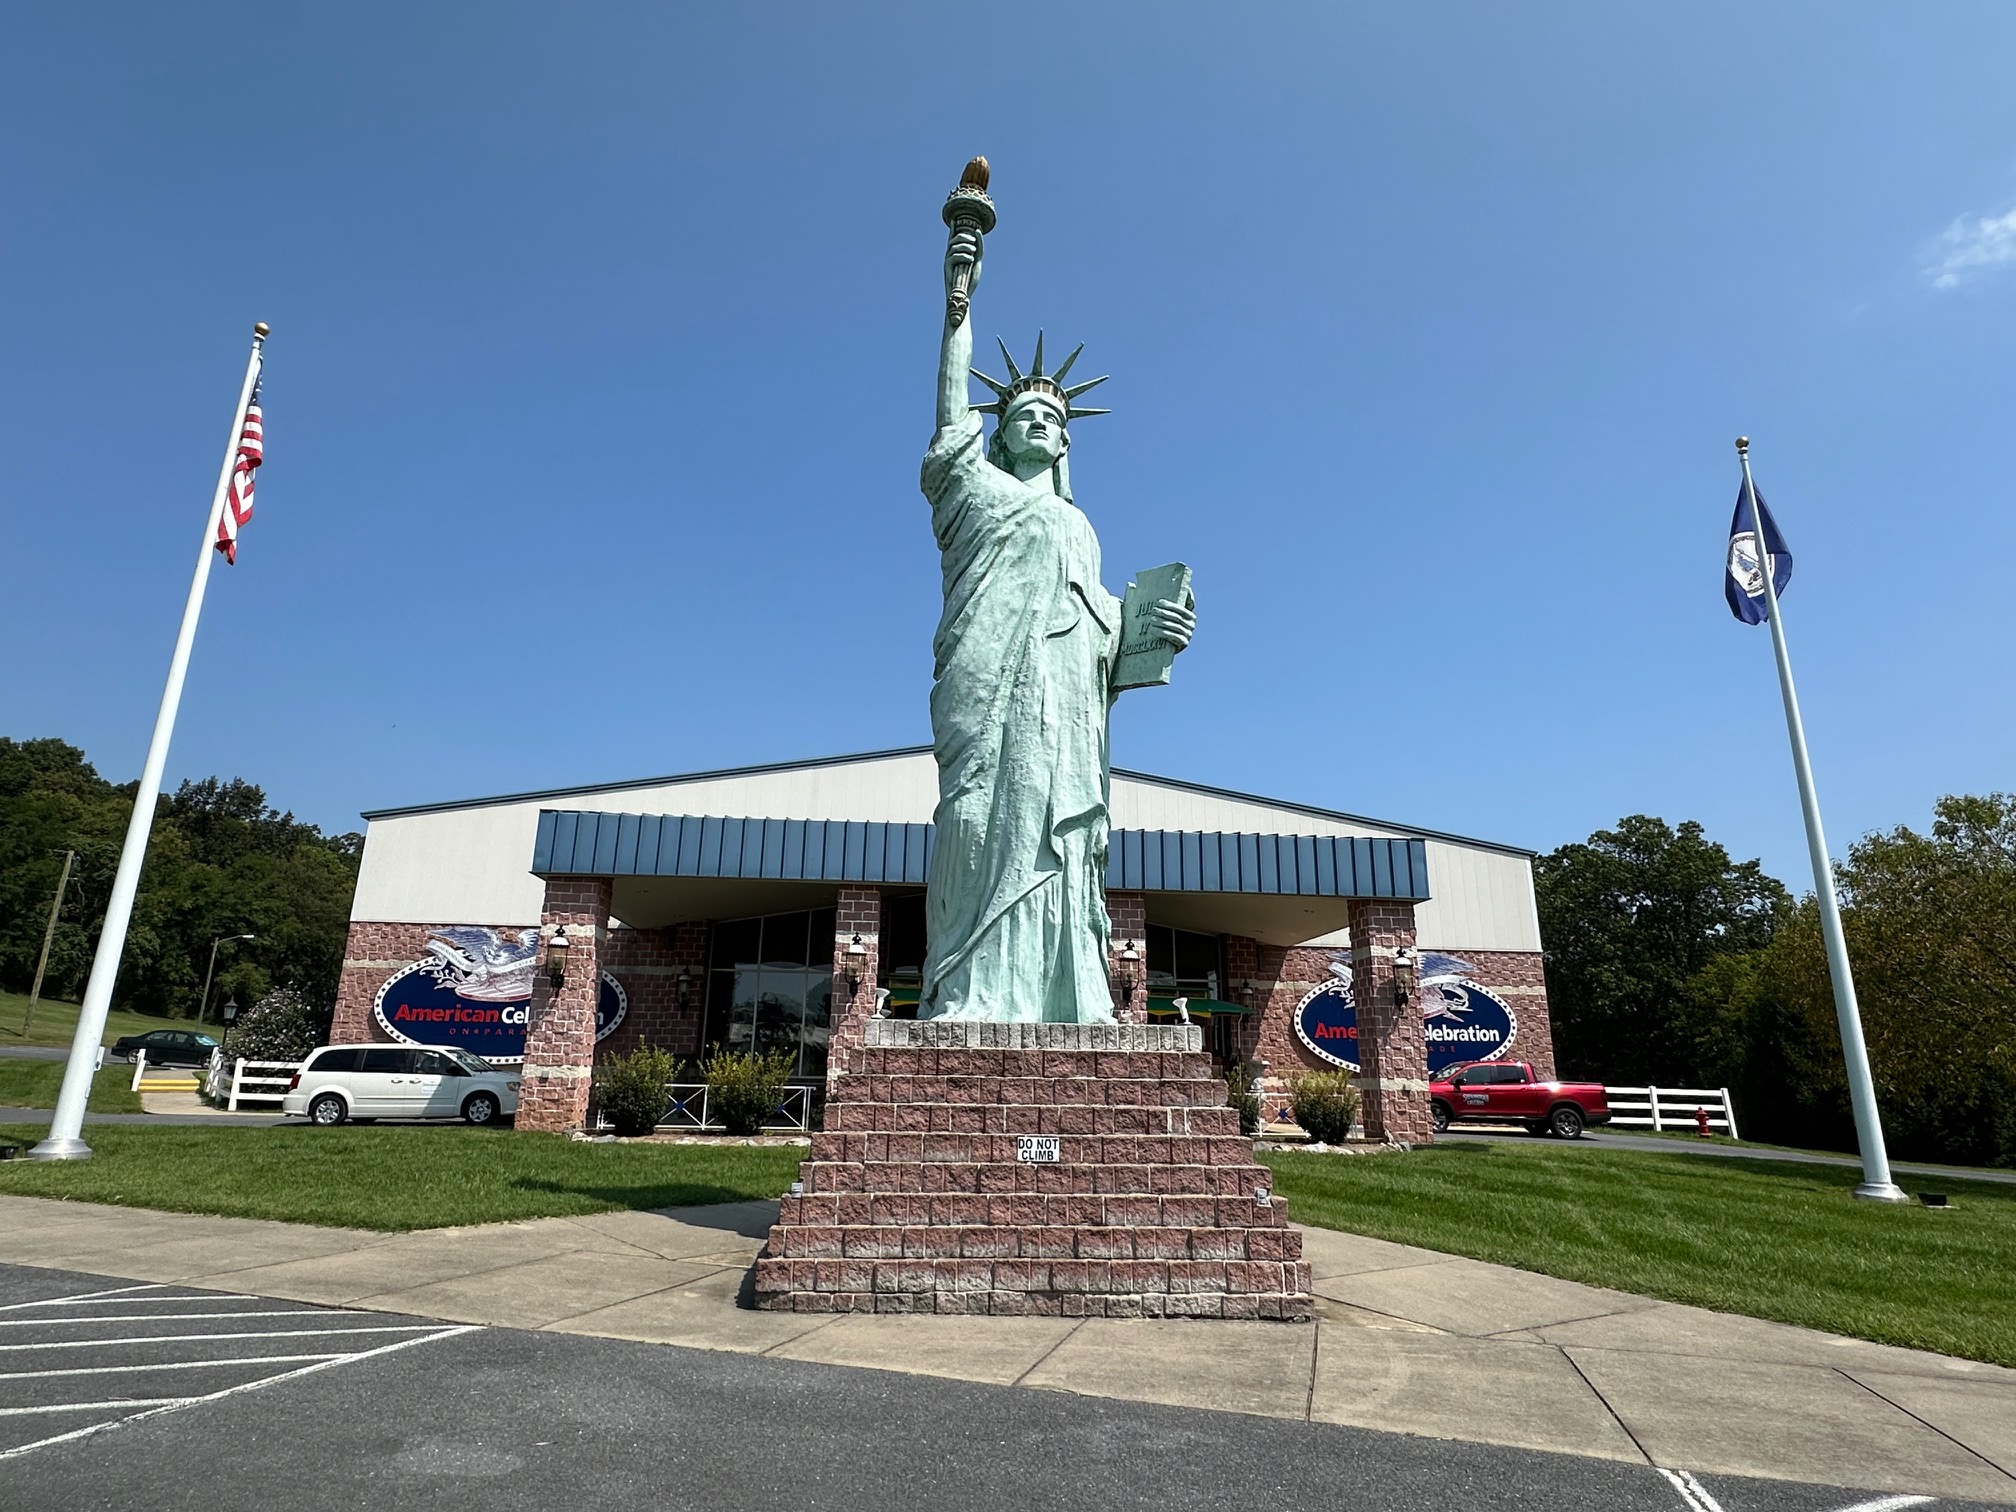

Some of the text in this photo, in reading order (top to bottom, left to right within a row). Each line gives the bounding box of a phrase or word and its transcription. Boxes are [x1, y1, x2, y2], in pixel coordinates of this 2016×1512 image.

[394, 1004, 499, 1022] American
[1018, 1138, 1058, 1150] DO NOT
[1021, 1150, 1054, 1161] CLIMB
